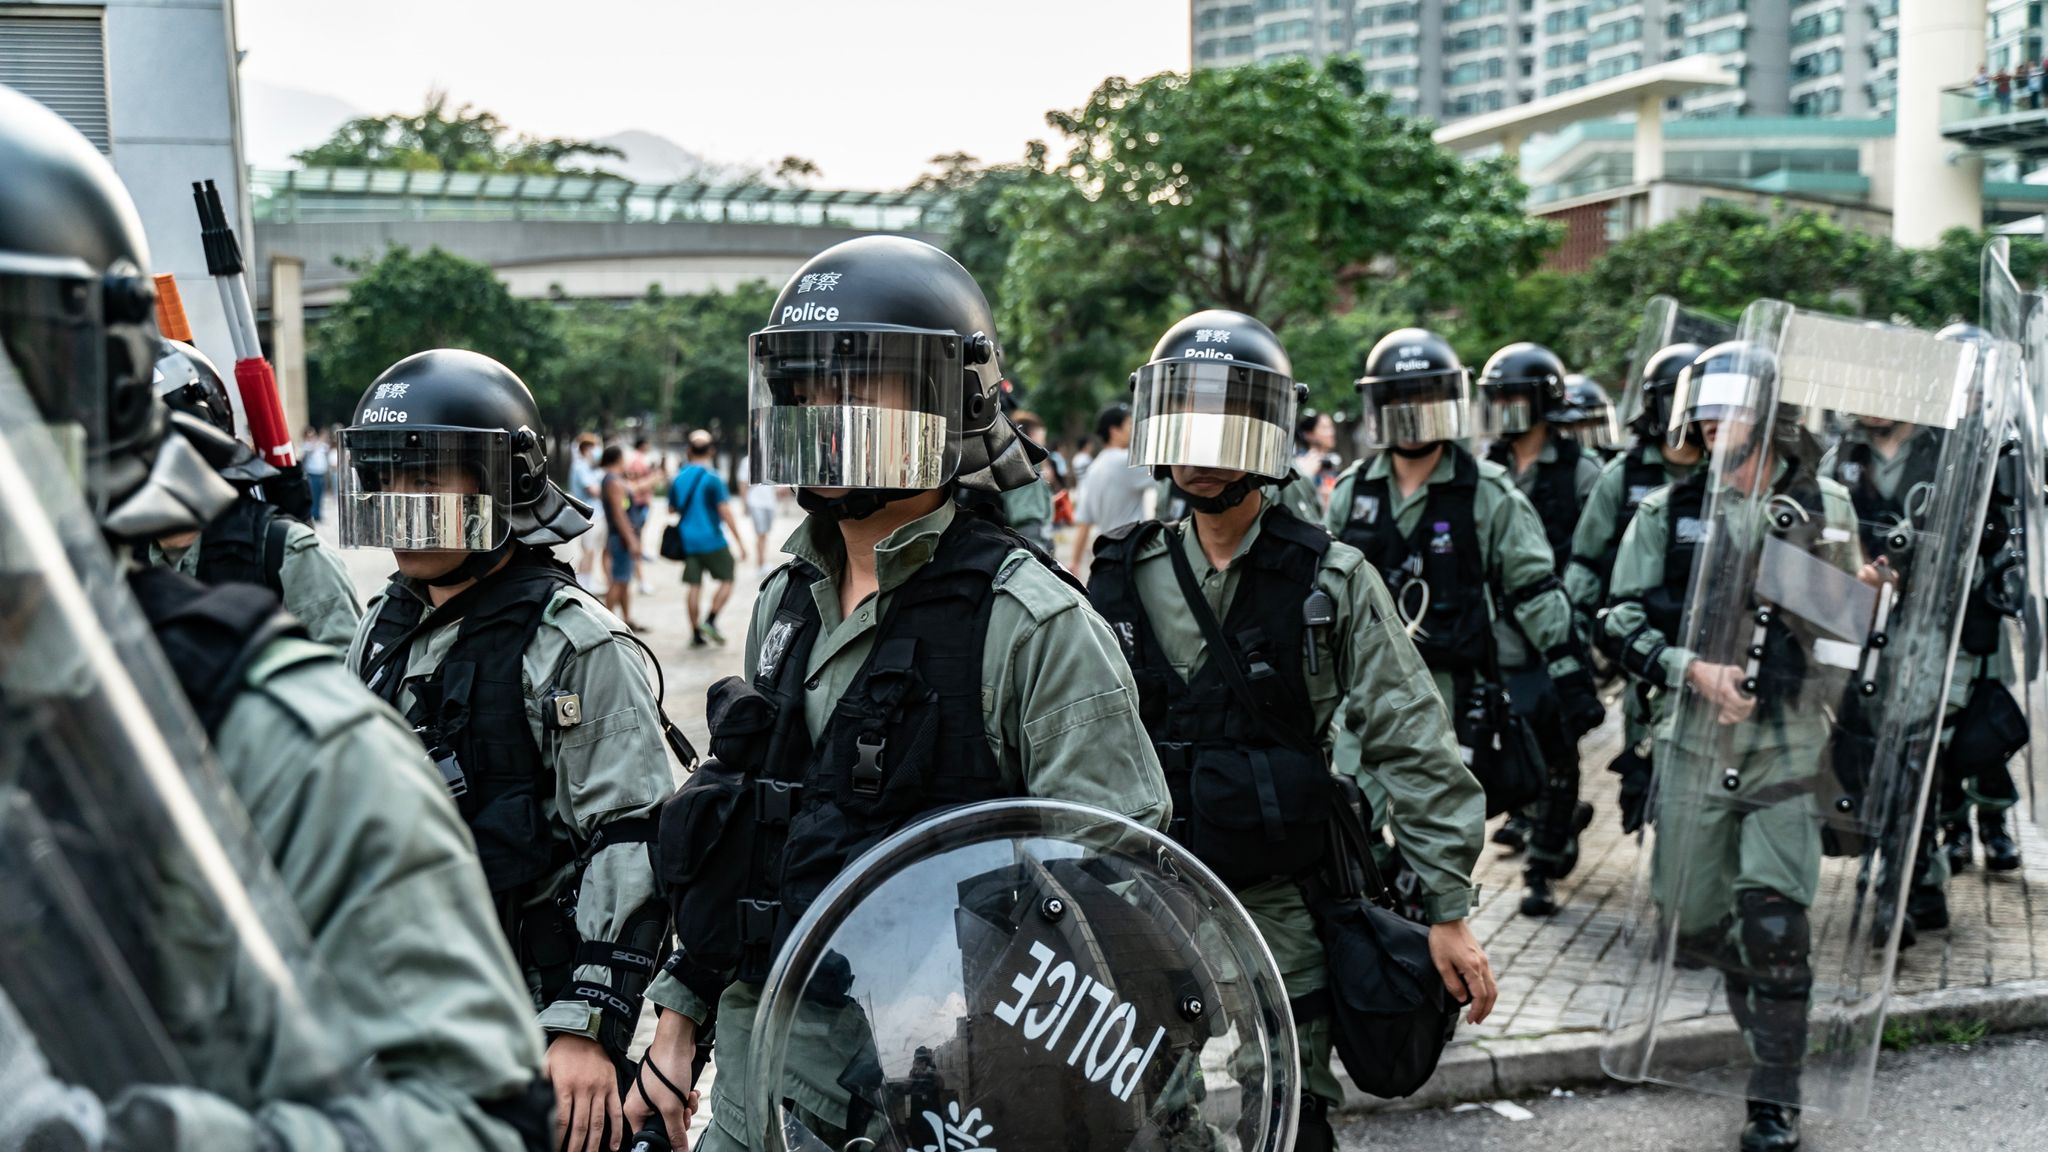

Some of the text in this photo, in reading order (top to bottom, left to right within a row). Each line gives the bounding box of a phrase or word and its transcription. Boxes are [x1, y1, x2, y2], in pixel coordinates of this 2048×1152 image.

[798, 272, 842, 294] 警察
[781, 302, 839, 324] Police
[1185, 348, 1233, 360] Police
[362, 407, 408, 424] Police
[994, 940, 1166, 1102] POLICE
